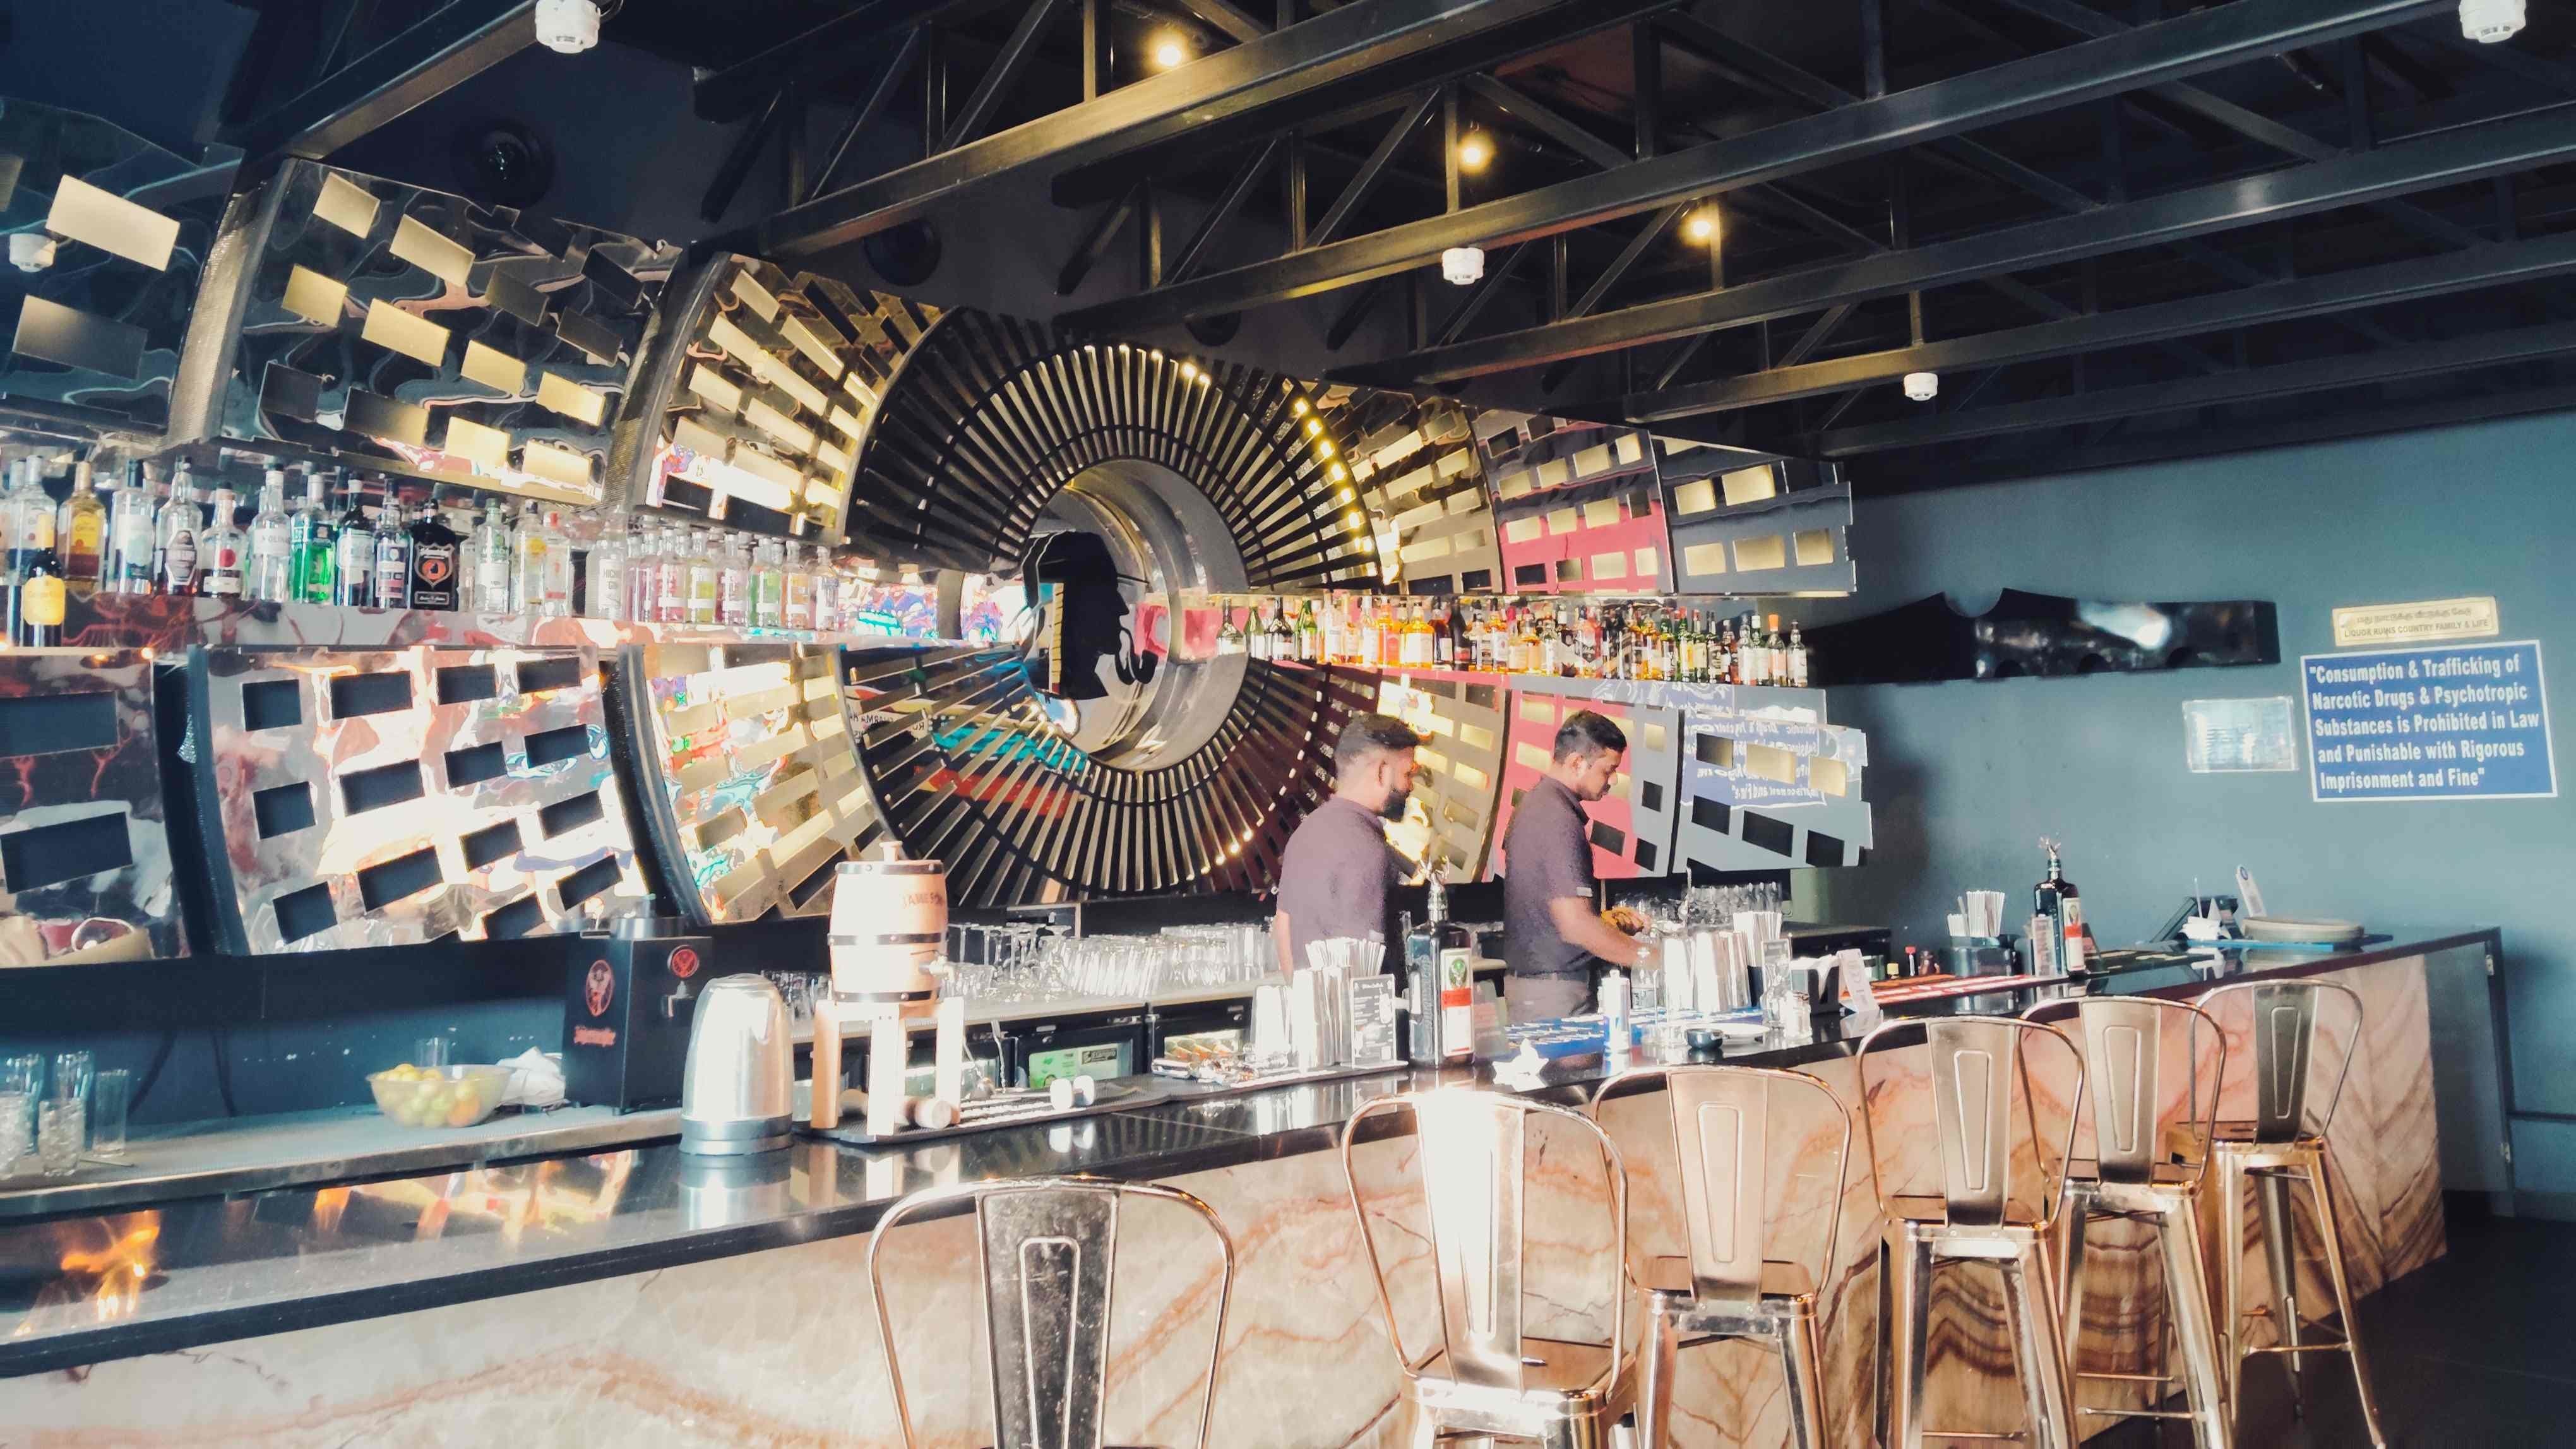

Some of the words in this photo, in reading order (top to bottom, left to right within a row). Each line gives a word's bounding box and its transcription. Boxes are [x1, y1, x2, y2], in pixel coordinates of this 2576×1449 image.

[2344, 628, 2373, 637] LIQUOR
[2398, 624, 2433, 634] COUNTRY
[2435, 620, 2462, 631] FAMILY
[2471, 619, 2488, 628] LIFE
[2309, 662, 2404, 684] "Consumption
[2407, 660, 2419, 678] &
[2423, 656, 2501, 677] Trafficking
[2505, 653, 2520, 672] of
[2312, 691, 2371, 710] Narcotic
[2375, 689, 2415, 710] Drugs
[2419, 686, 2431, 706] &
[2435, 683, 2528, 707] Psychotropic
[2315, 717, 2394, 737] Substances
[2397, 715, 2410, 733] is
[2414, 711, 2488, 732] Prohibited
[2491, 711, 2506, 729] in
[2510, 710, 2539, 728] Law
[2318, 744, 2342, 764] and
[2346, 742, 2421, 763] Punishable
[2424, 741, 2457, 760] with
[2460, 739, 2525, 763] Rigorous
[2320, 771, 2414, 794] Imprisonment
[2418, 768, 2443, 788] and
[2447, 767, 2485, 787] Fine"
